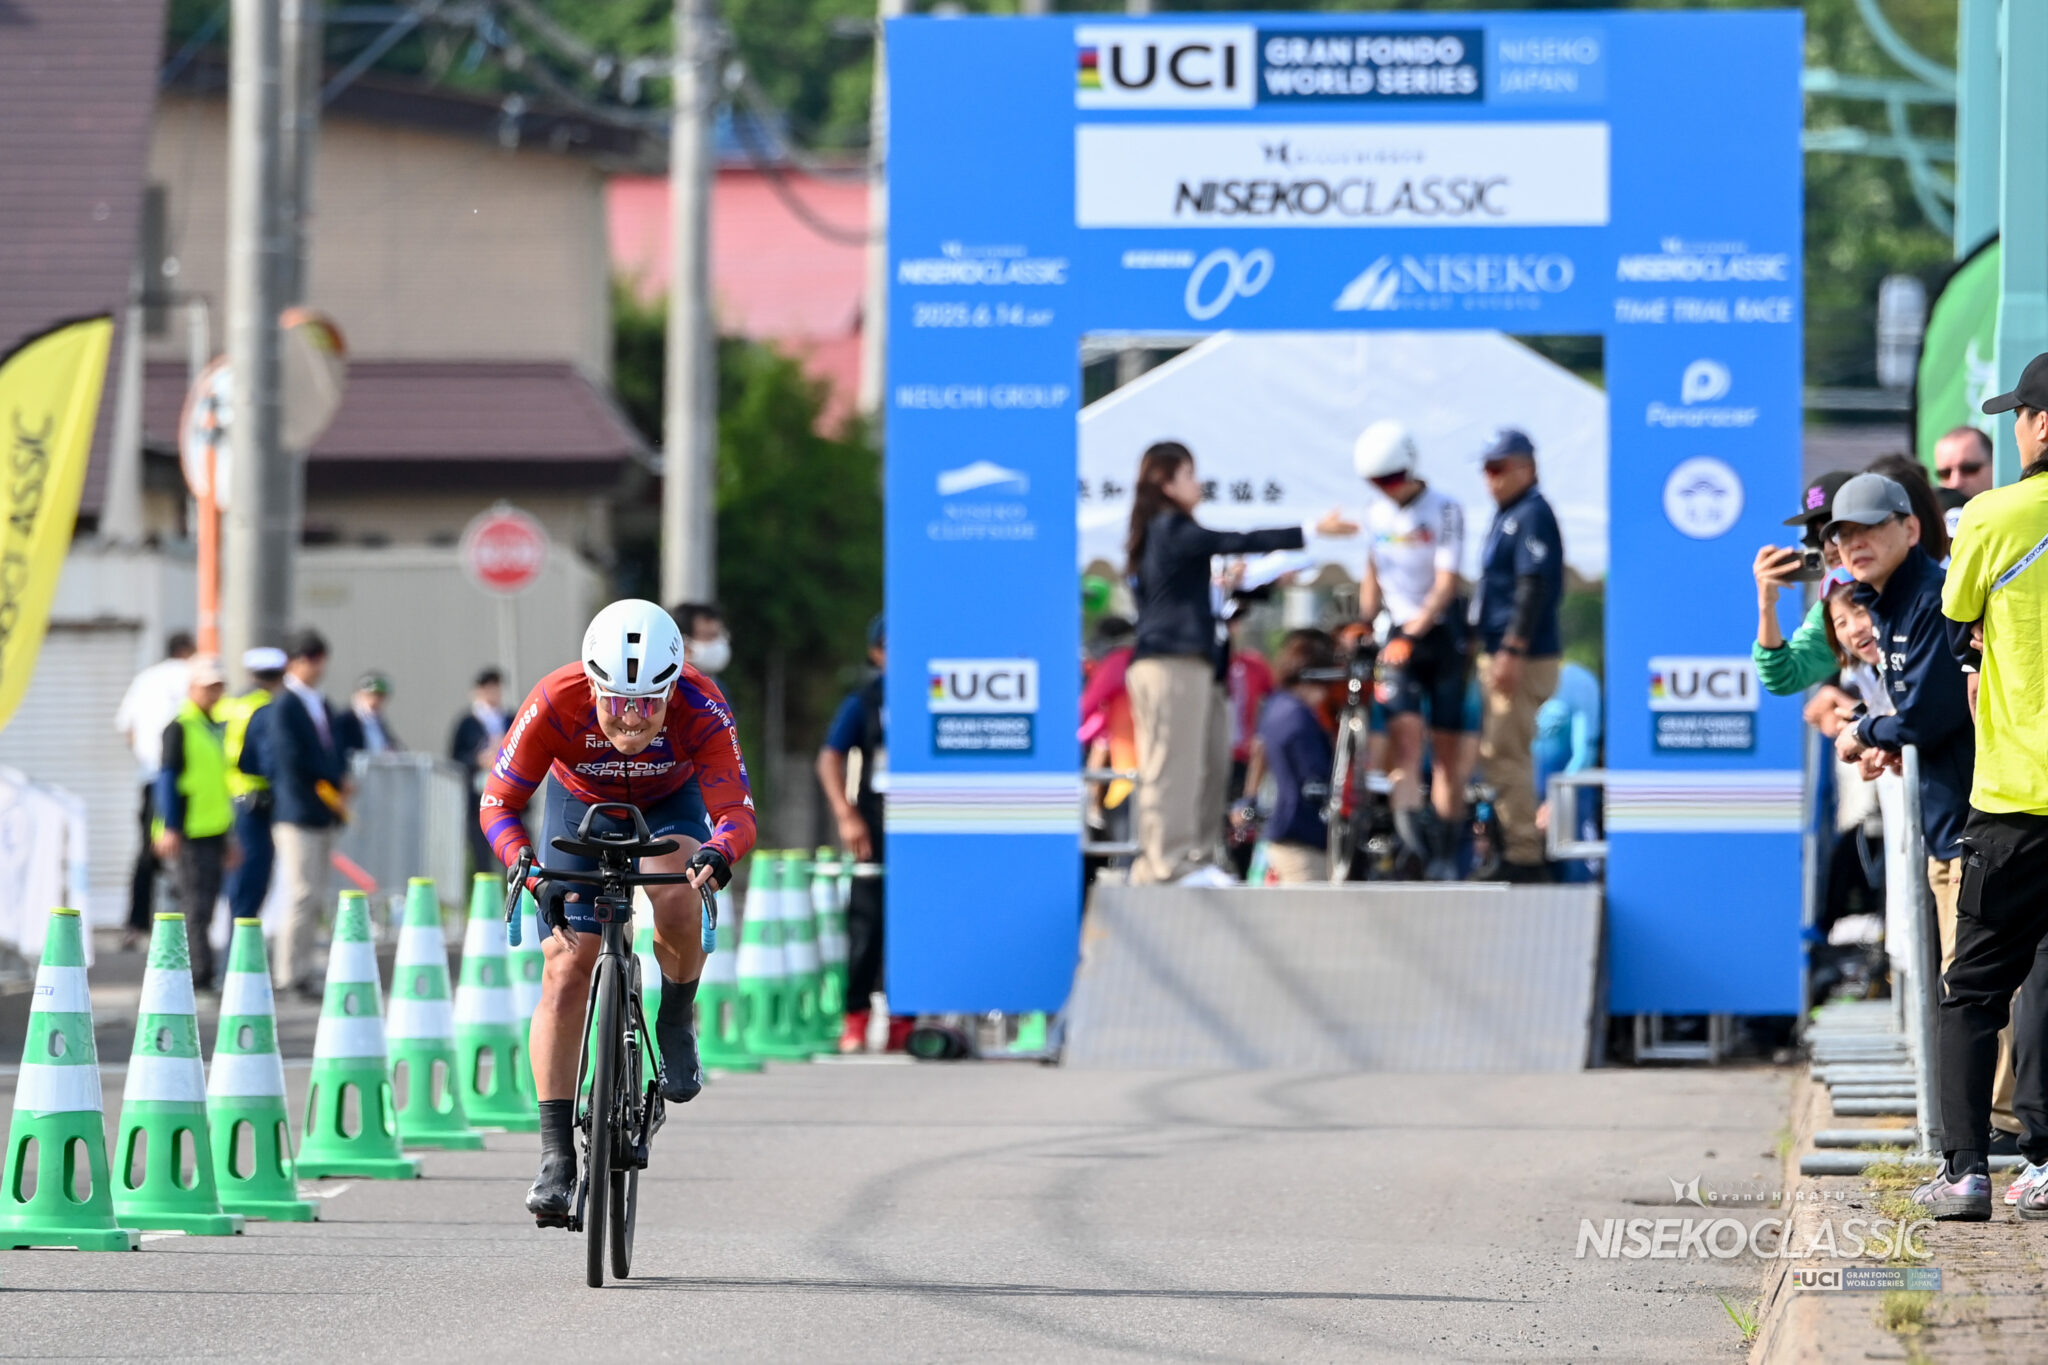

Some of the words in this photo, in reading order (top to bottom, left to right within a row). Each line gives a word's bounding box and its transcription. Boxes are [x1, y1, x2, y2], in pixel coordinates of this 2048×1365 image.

[1264, 37, 1352, 66] GRAN
[1355, 36, 1464, 65] FONDO
[1500, 37, 1599, 65] NISEKO
[1111, 45, 1237, 89] UCI
[1264, 67, 1375, 96] WORLD
[1376, 66, 1478, 95] SERIES
[1498, 68, 1579, 95] JAPAN
[1174, 178, 1510, 217] NISEKOCLASSIC
[1399, 254, 1575, 294] NISEKO
[1615, 298, 1667, 323] TIME
[1673, 298, 1729, 323] TRIAL
[1734, 297, 1793, 323] RACE
[950, 673, 1026, 701] UCI
[1671, 671, 1747, 699] UCI
[705, 699, 730, 727] Flying
[729, 726, 741, 760] Colors
